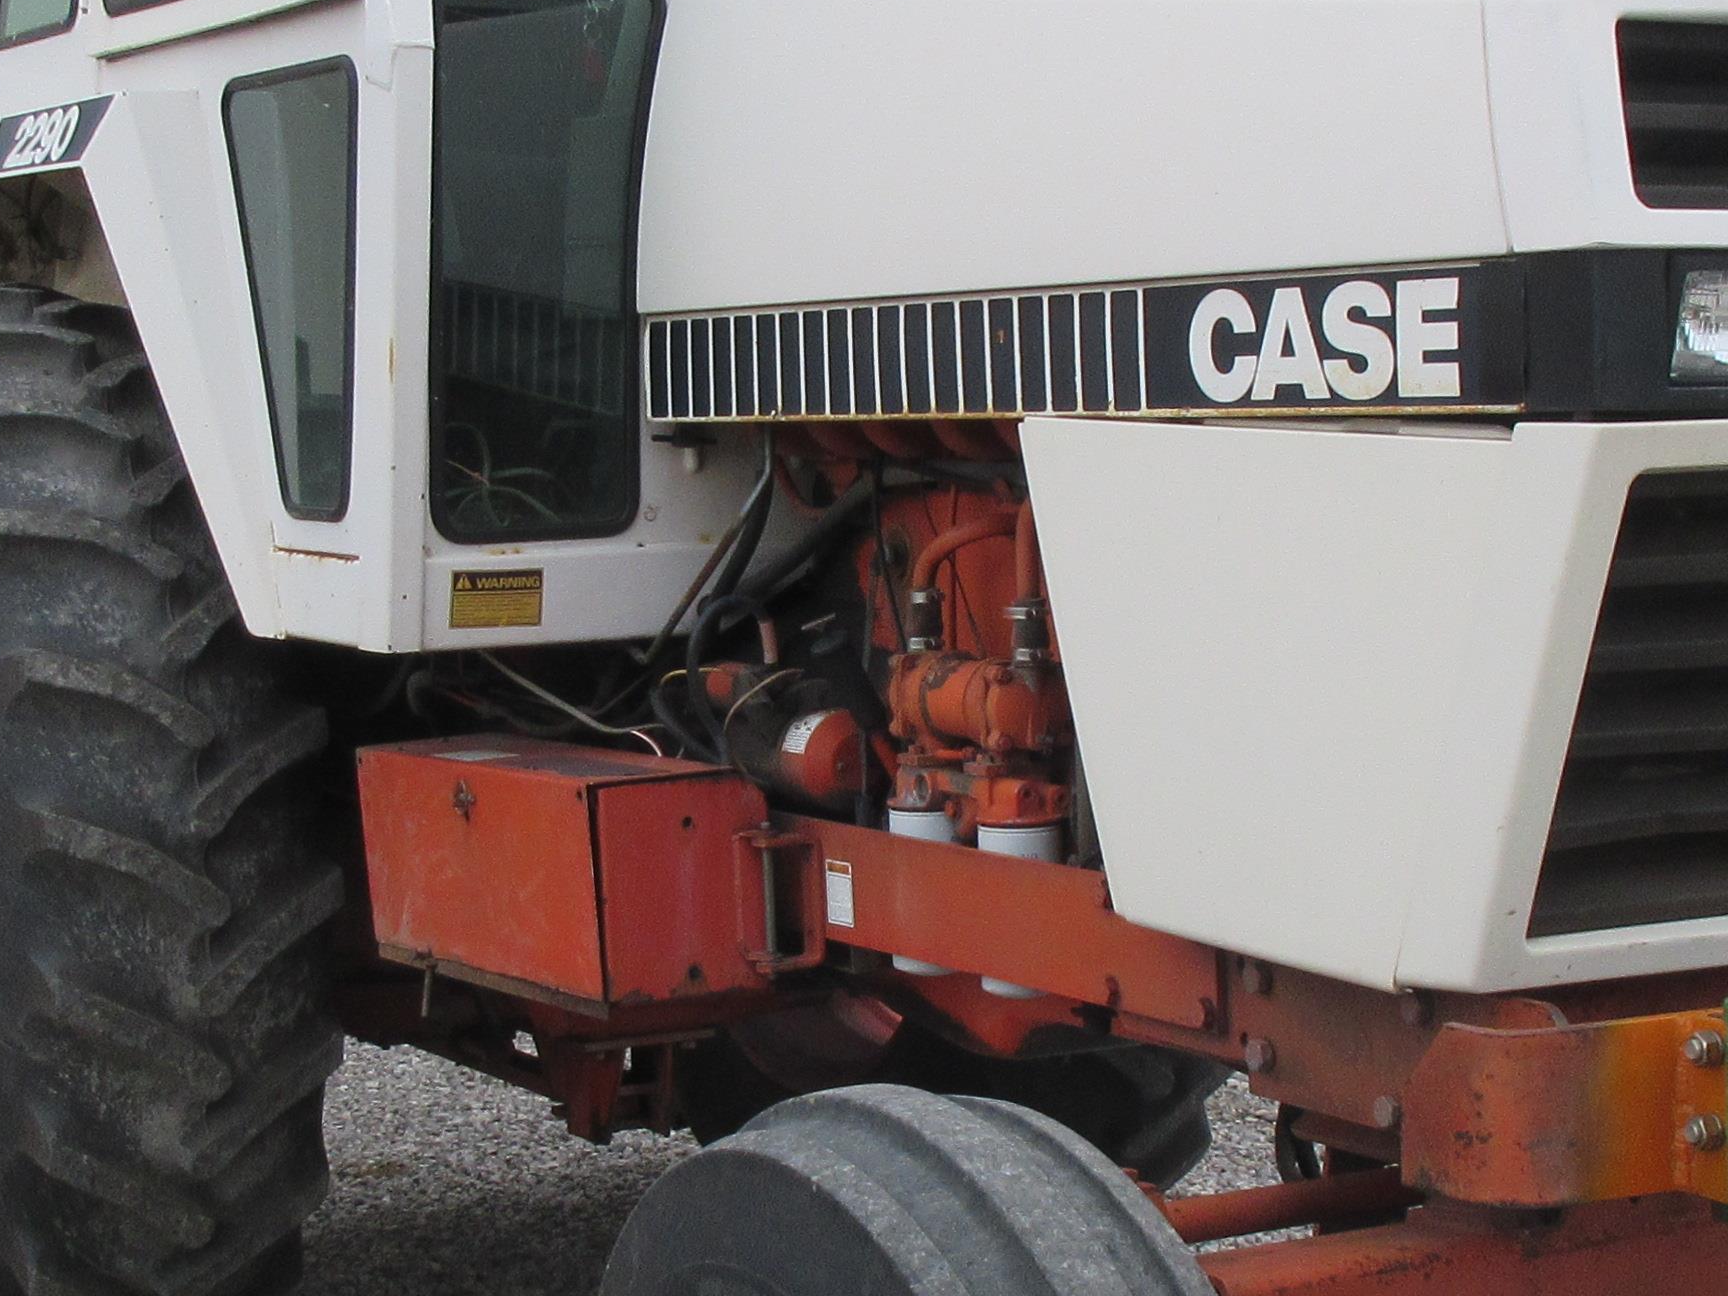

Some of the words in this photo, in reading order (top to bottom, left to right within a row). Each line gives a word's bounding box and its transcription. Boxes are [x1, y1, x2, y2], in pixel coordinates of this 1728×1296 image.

[3, 105, 80, 169] 2290
[1189, 277, 1461, 403] CASE
[476, 576, 540, 589] WARNING
